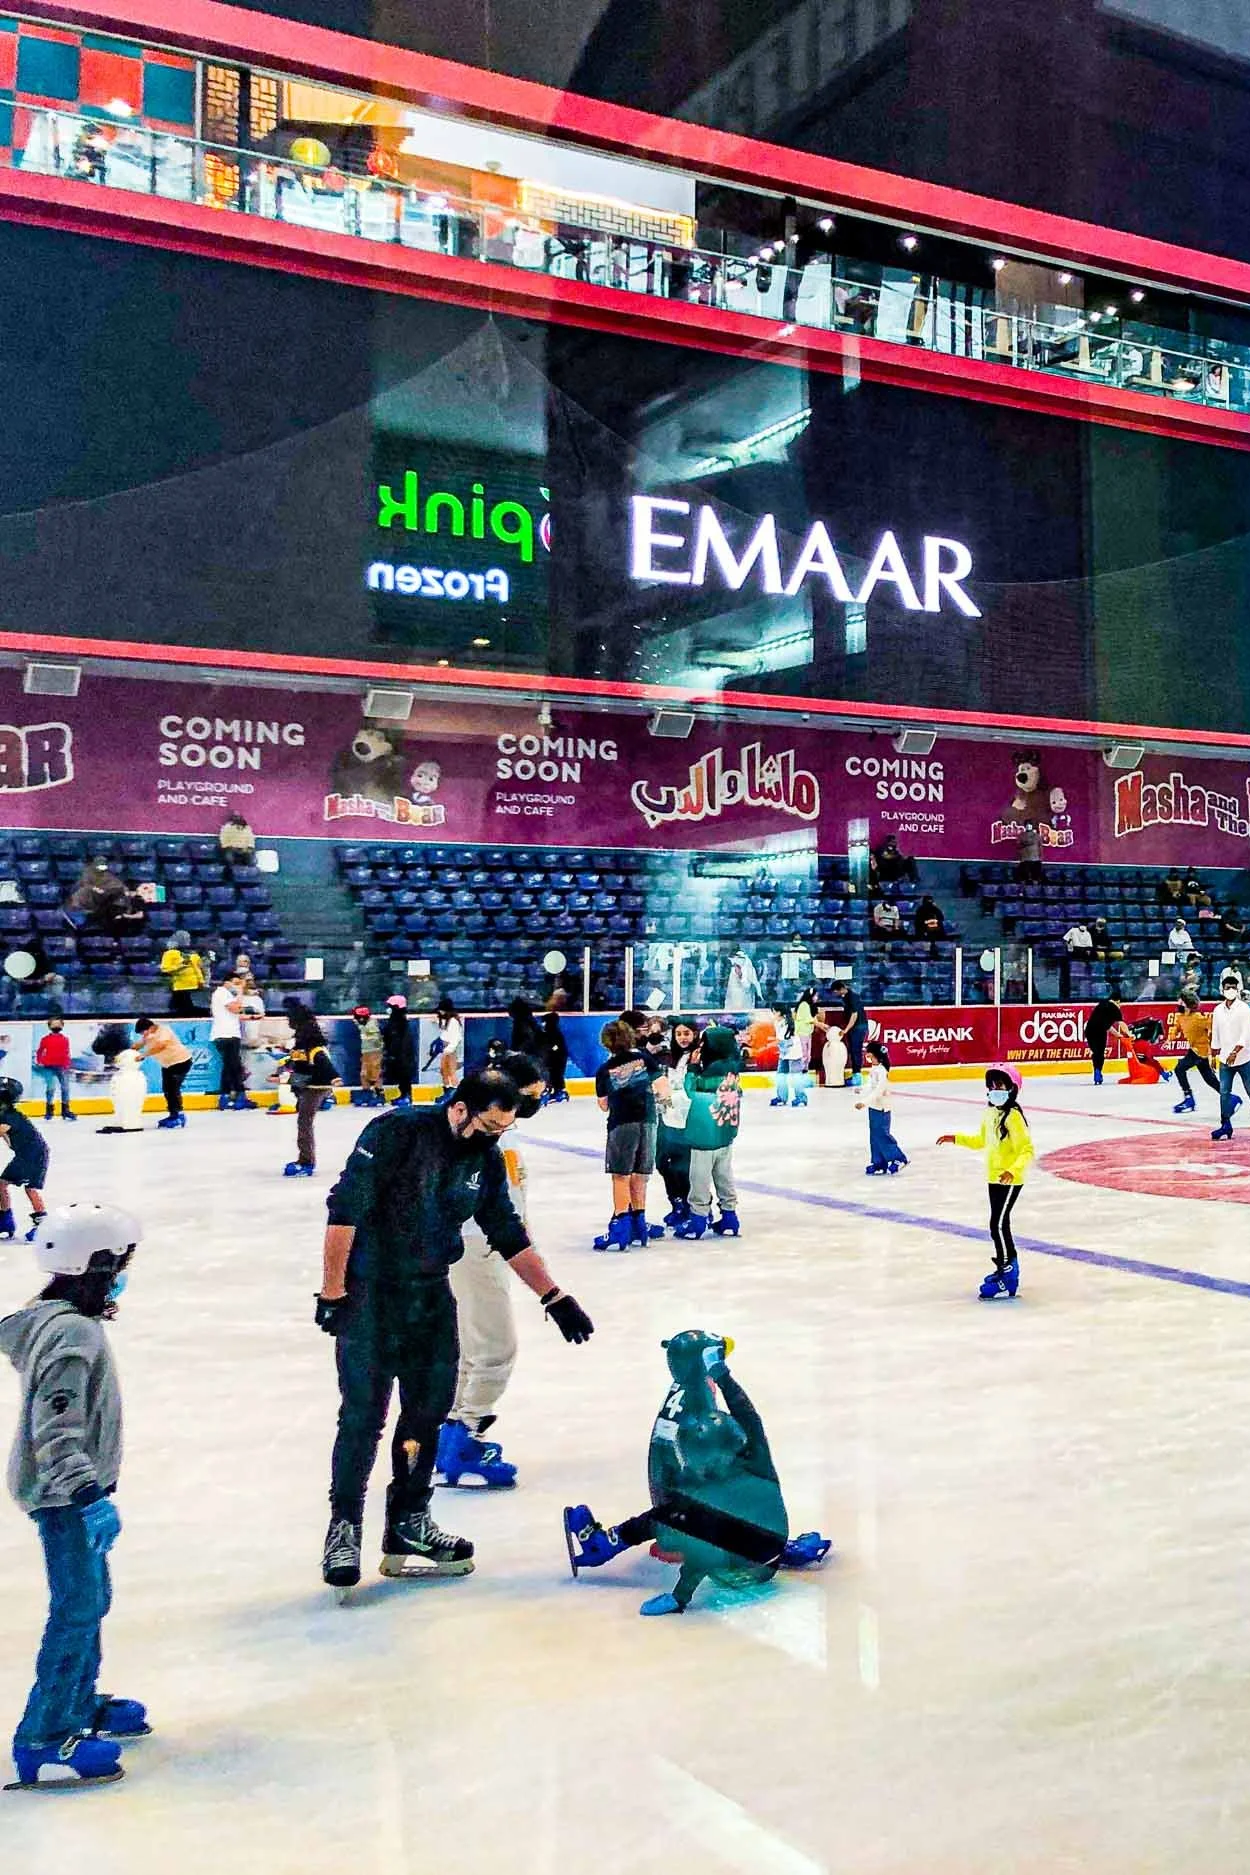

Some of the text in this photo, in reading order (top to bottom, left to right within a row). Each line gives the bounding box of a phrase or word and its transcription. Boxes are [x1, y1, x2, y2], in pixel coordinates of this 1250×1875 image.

[630, 494, 982, 618] EMAAR
[160, 715, 304, 746] COMING
[159, 743, 261, 770] SOON
[498, 734, 618, 761] COMING
[496, 759, 581, 783] SOON
[845, 757, 944, 781] COMING
[158, 780, 254, 795] PLAYGROUND
[496, 792, 575, 805] PLAYGROUND
[876, 781, 944, 802] SOON
[158, 795, 228, 807] AND CAFE
[496, 805, 554, 816] AND CAFE
[1114, 771, 1208, 838] Masha
[1207, 792, 1240, 817] and
[881, 811, 945, 822] PLAYGROUND
[1217, 814, 1250, 836] The
[899, 823, 945, 834] AND CAFE
[884, 1027, 973, 1043] RAKBANK
[1020, 1010, 1089, 1043] deal
[1007, 1049, 1027, 1060] WHY
[1028, 1049, 1045, 1059] PAY
[1046, 1048, 1061, 1058] THE
[1062, 1047, 1082, 1058] FULL
